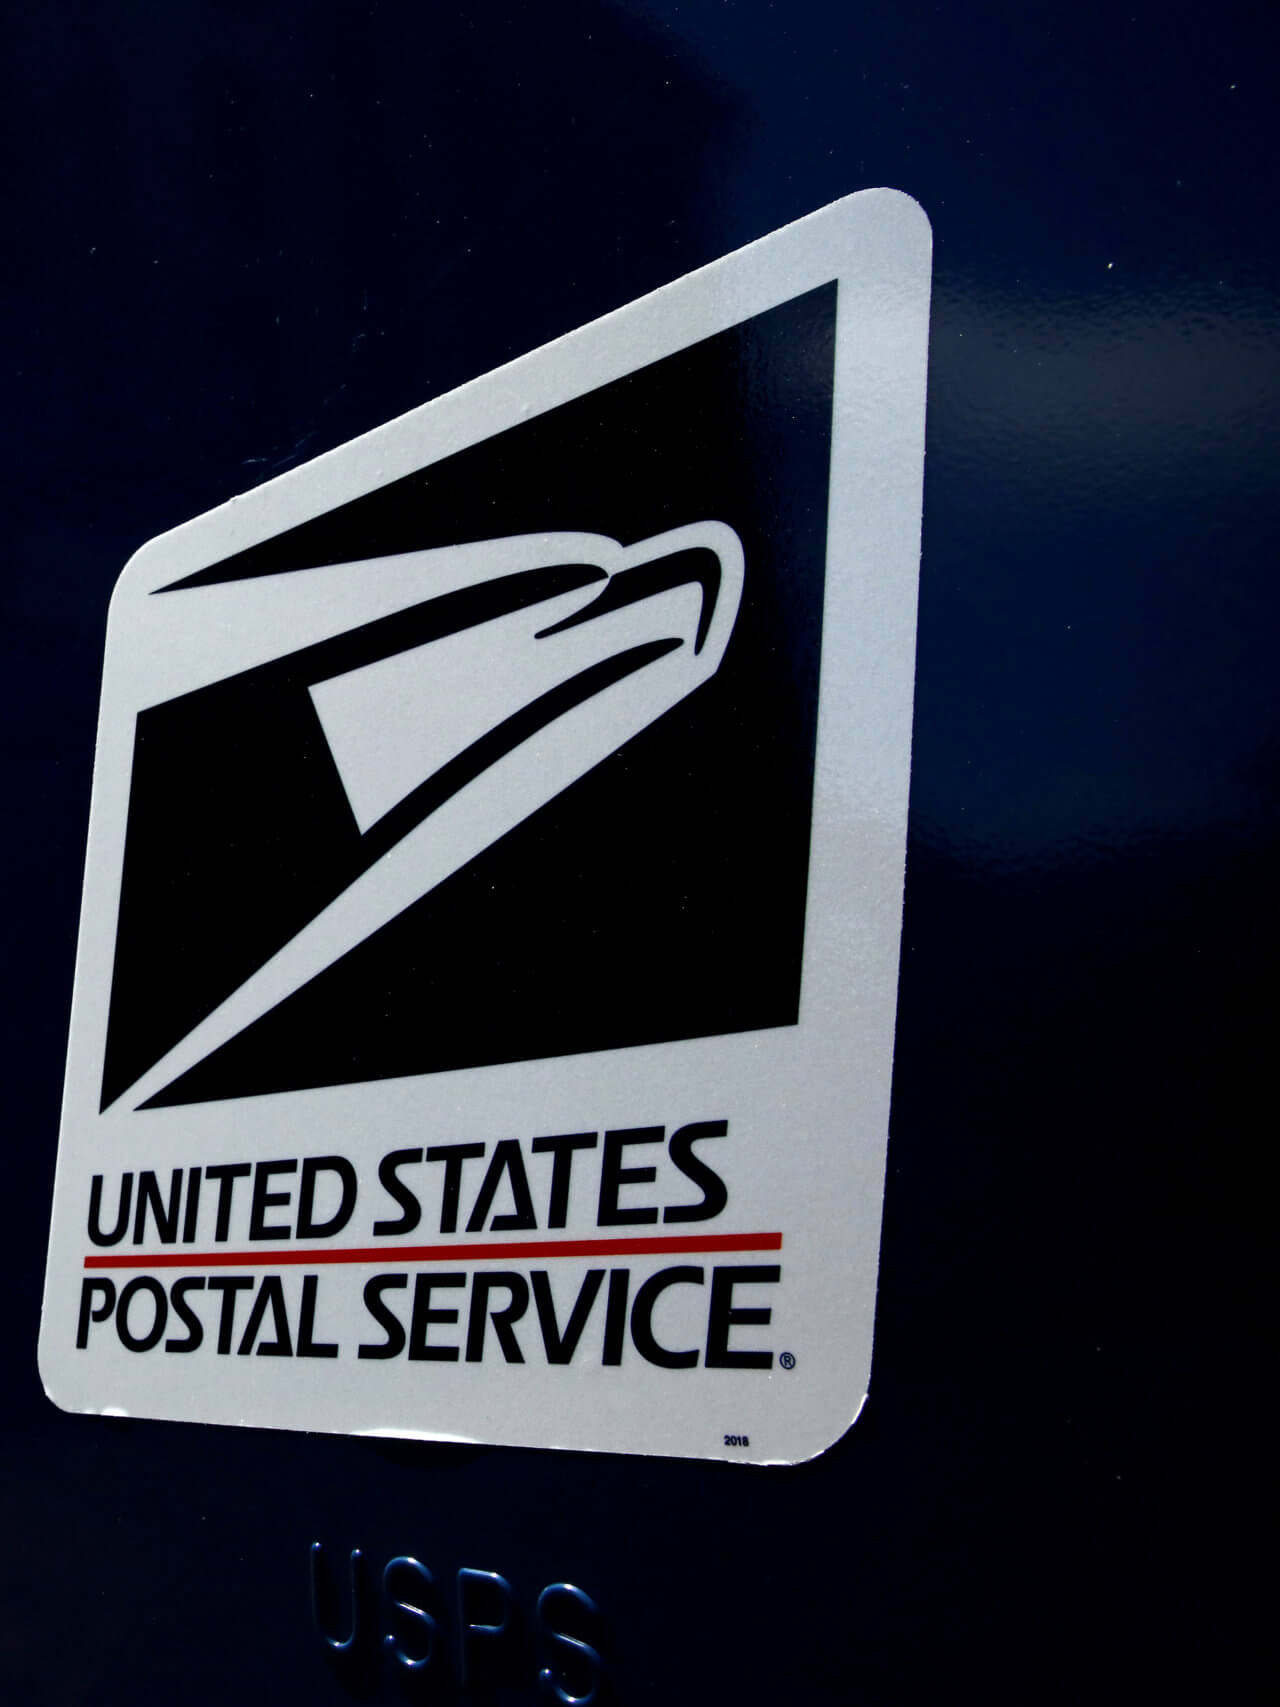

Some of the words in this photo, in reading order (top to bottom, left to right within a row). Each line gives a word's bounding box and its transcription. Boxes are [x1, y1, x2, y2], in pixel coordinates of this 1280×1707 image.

[87, 1155, 358, 1248] UNITED
[372, 1119, 729, 1237] STATES
[76, 1274, 339, 1359] POSTAL
[723, 1434, 750, 1448] 2018
[309, 1541, 602, 1706] USPS
